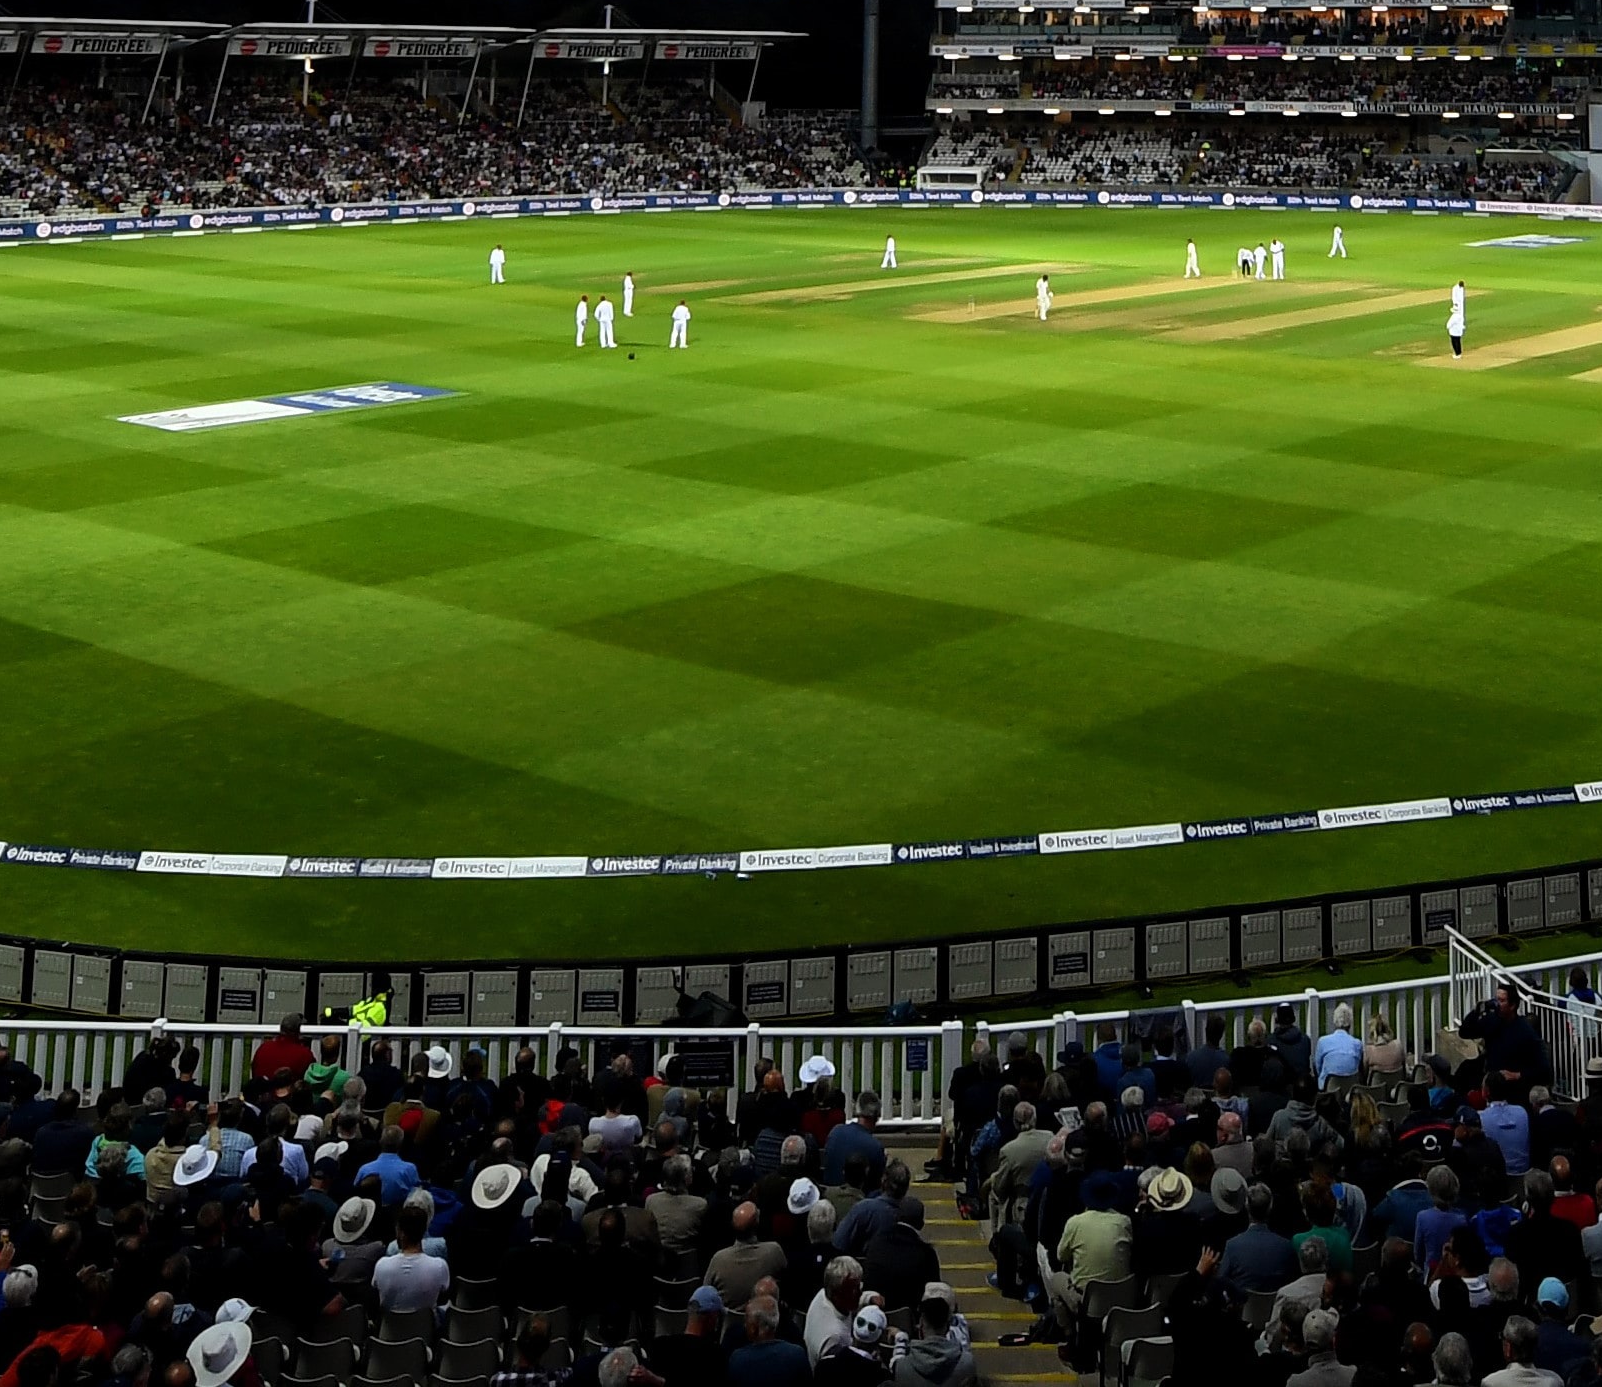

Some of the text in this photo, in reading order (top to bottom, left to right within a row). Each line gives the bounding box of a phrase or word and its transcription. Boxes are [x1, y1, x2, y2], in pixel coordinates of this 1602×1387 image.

[70, 39, 146, 53] PEDIGREE
[266, 41, 335, 54] PEDIGREE
[397, 43, 463, 56] PEDIGREE
[567, 45, 629, 57] PEDIGREE
[685, 47, 744, 58] PEDIGREE
[861, 192, 899, 201] dgbaston
[984, 192, 1026, 202] edgbaston
[1111, 194, 1152, 203] edgbaston
[1235, 195, 1277, 205] edgbaston
[1363, 198, 1407, 207] edgbaston
[136, 218, 178, 229] Test Match
[204, 214, 252, 227] edgbaston
[52, 222, 104, 235] edgbaston
[1464, 795, 1510, 811] Investec
[1334, 802, 1450, 824] Investec Corporate Banking
[1197, 813, 1317, 837] Investec Private Banking
[1056, 829, 1181, 849] Investec Asset Management
[16, 846, 67, 864] Investec
[758, 850, 889, 866] Investec Corporate Banking
[909, 843, 963, 860] Investec
[154, 855, 282, 875] Investec Corporate Banking
[301, 859, 355, 875] Investec
[450, 860, 505, 875] Investec
[512, 861, 532, 874] Asset
[603, 856, 736, 872] Investec Private Banking
